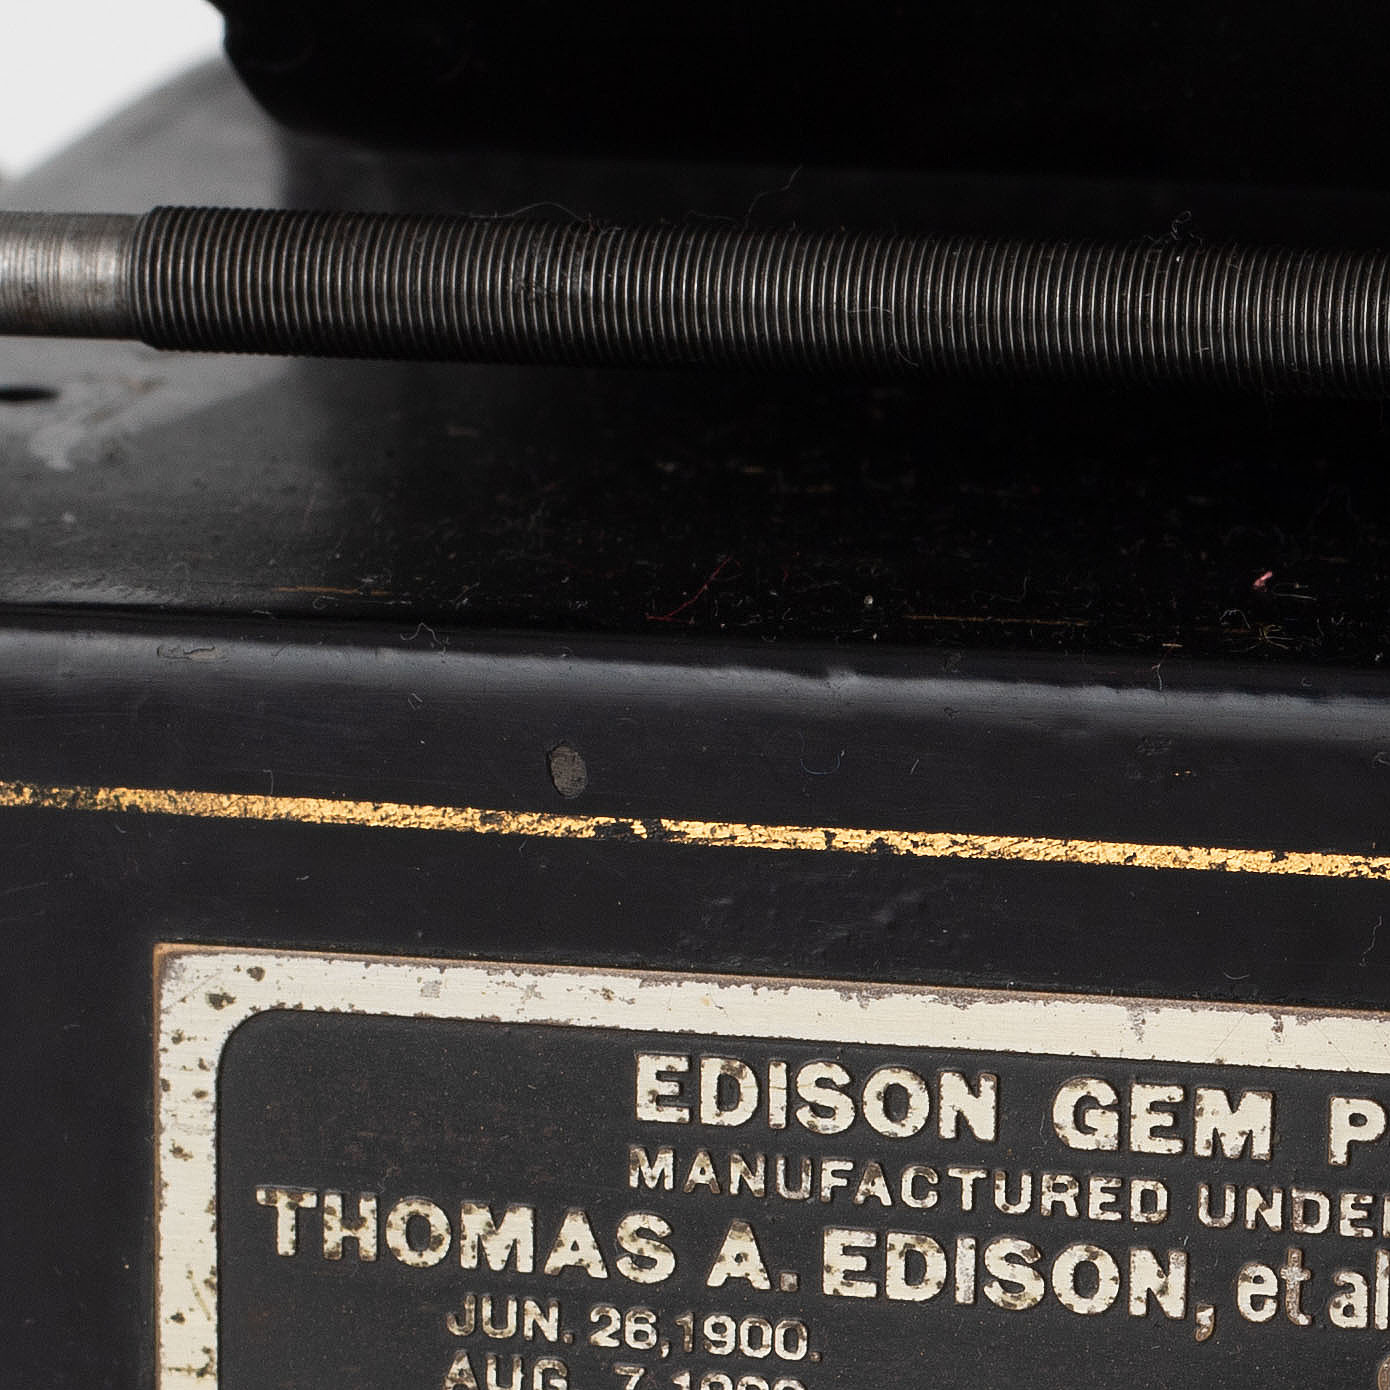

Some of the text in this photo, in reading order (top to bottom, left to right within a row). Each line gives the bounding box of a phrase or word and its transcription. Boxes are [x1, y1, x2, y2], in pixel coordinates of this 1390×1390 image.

[633, 1049, 997, 1142] EDISON
[1050, 1074, 1273, 1161] GEM
[628, 1143, 1169, 1224] MANUFACTURED
[255, 1183, 676, 1285] THOMAS
[705, 1218, 798, 1292] A.
[821, 1224, 1215, 1342] EDISON,
[1236, 1246, 1312, 1326] et
[445, 1291, 820, 1362] JUN. 26,1900.
